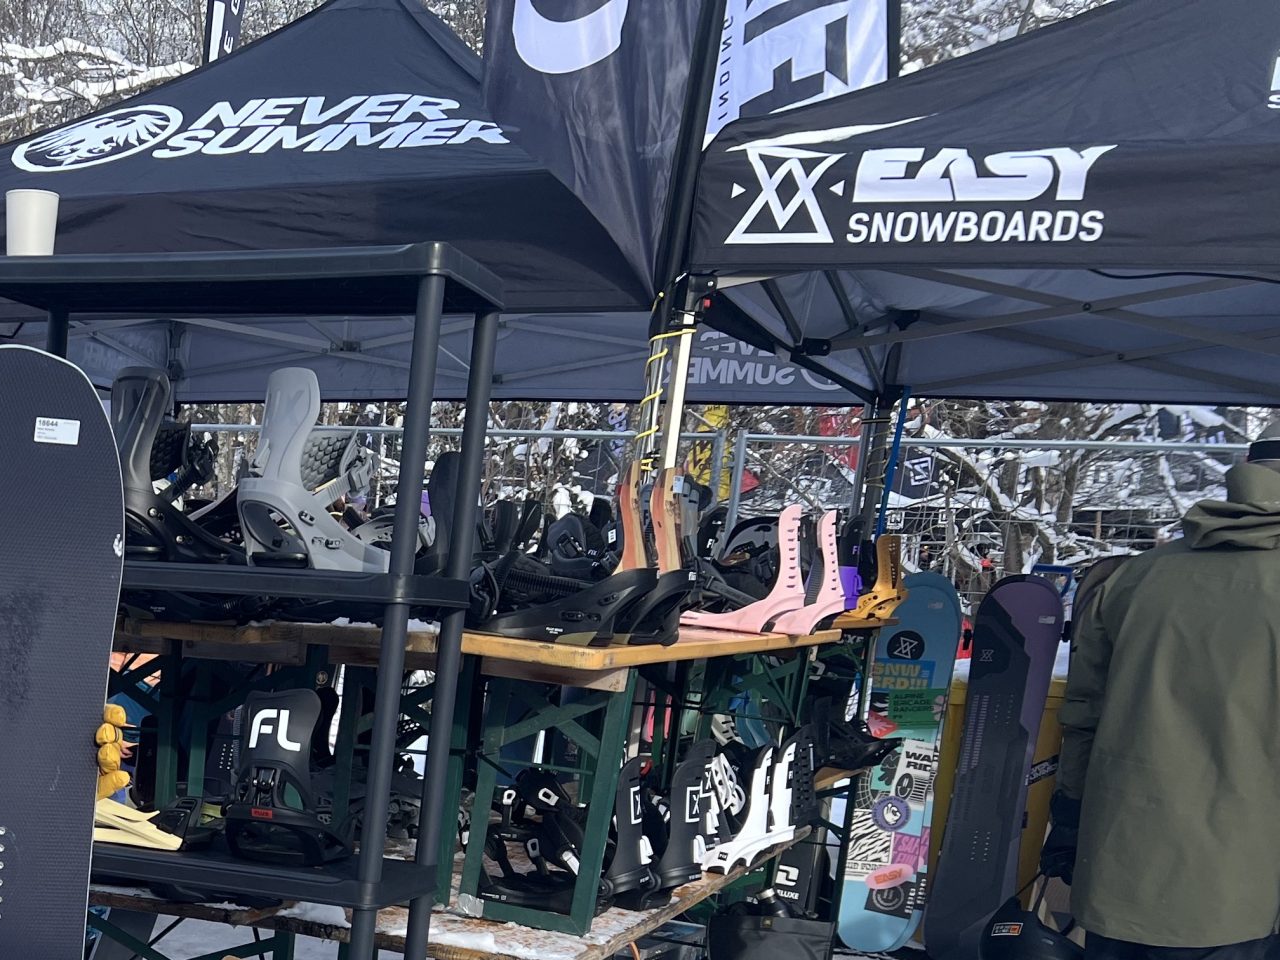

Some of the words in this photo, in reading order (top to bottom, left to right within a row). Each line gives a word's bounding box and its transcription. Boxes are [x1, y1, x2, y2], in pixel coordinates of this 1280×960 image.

[188, 93, 461, 130] NEVER
[151, 119, 510, 159] SUMMER
[852, 144, 1117, 202] EASY
[846, 210, 1104, 243] SNOWBOARDS
[777, 889, 799, 900] ELUXE
[874, 869, 903, 885] EASY
